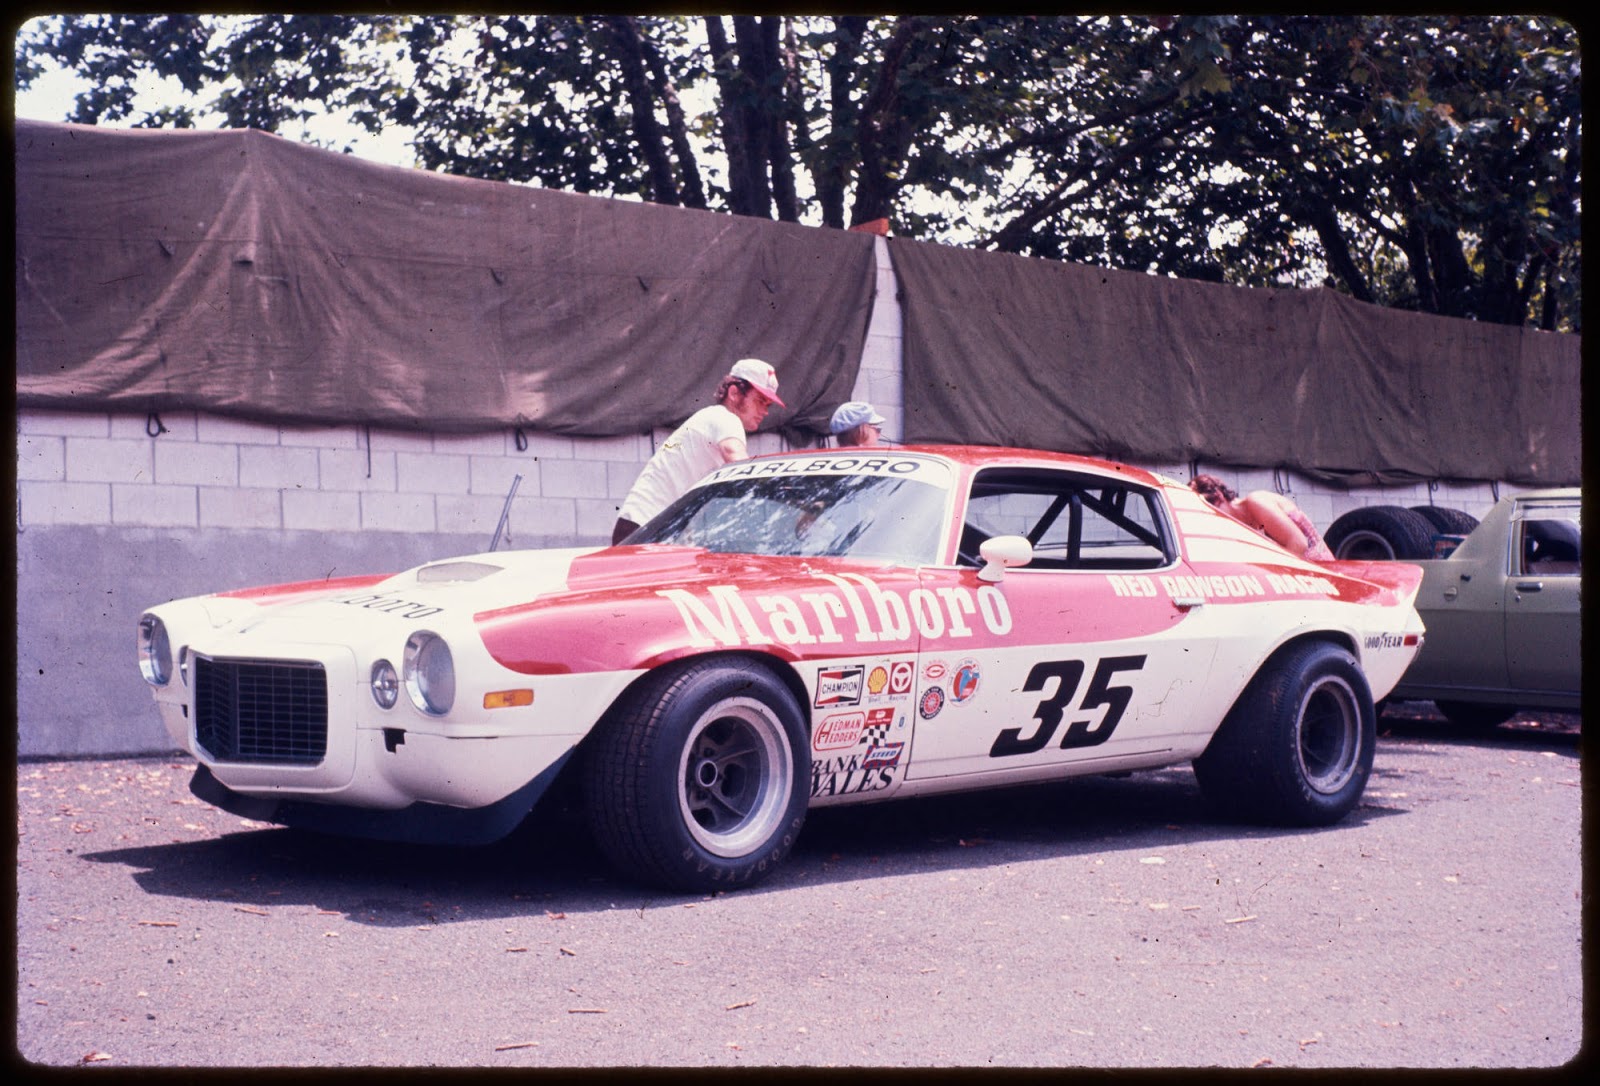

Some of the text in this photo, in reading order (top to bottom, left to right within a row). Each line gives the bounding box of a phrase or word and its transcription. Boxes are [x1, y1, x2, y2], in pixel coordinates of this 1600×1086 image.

[705, 459, 921, 481] MARLBORO
[1106, 574, 1157, 598] RED
[1159, 575, 1265, 598] DAWSON
[655, 571, 1012, 649] Marlboro
[822, 681, 858, 695] CHAMPION
[989, 654, 1148, 758] 35
[811, 754, 862, 775] BANK
